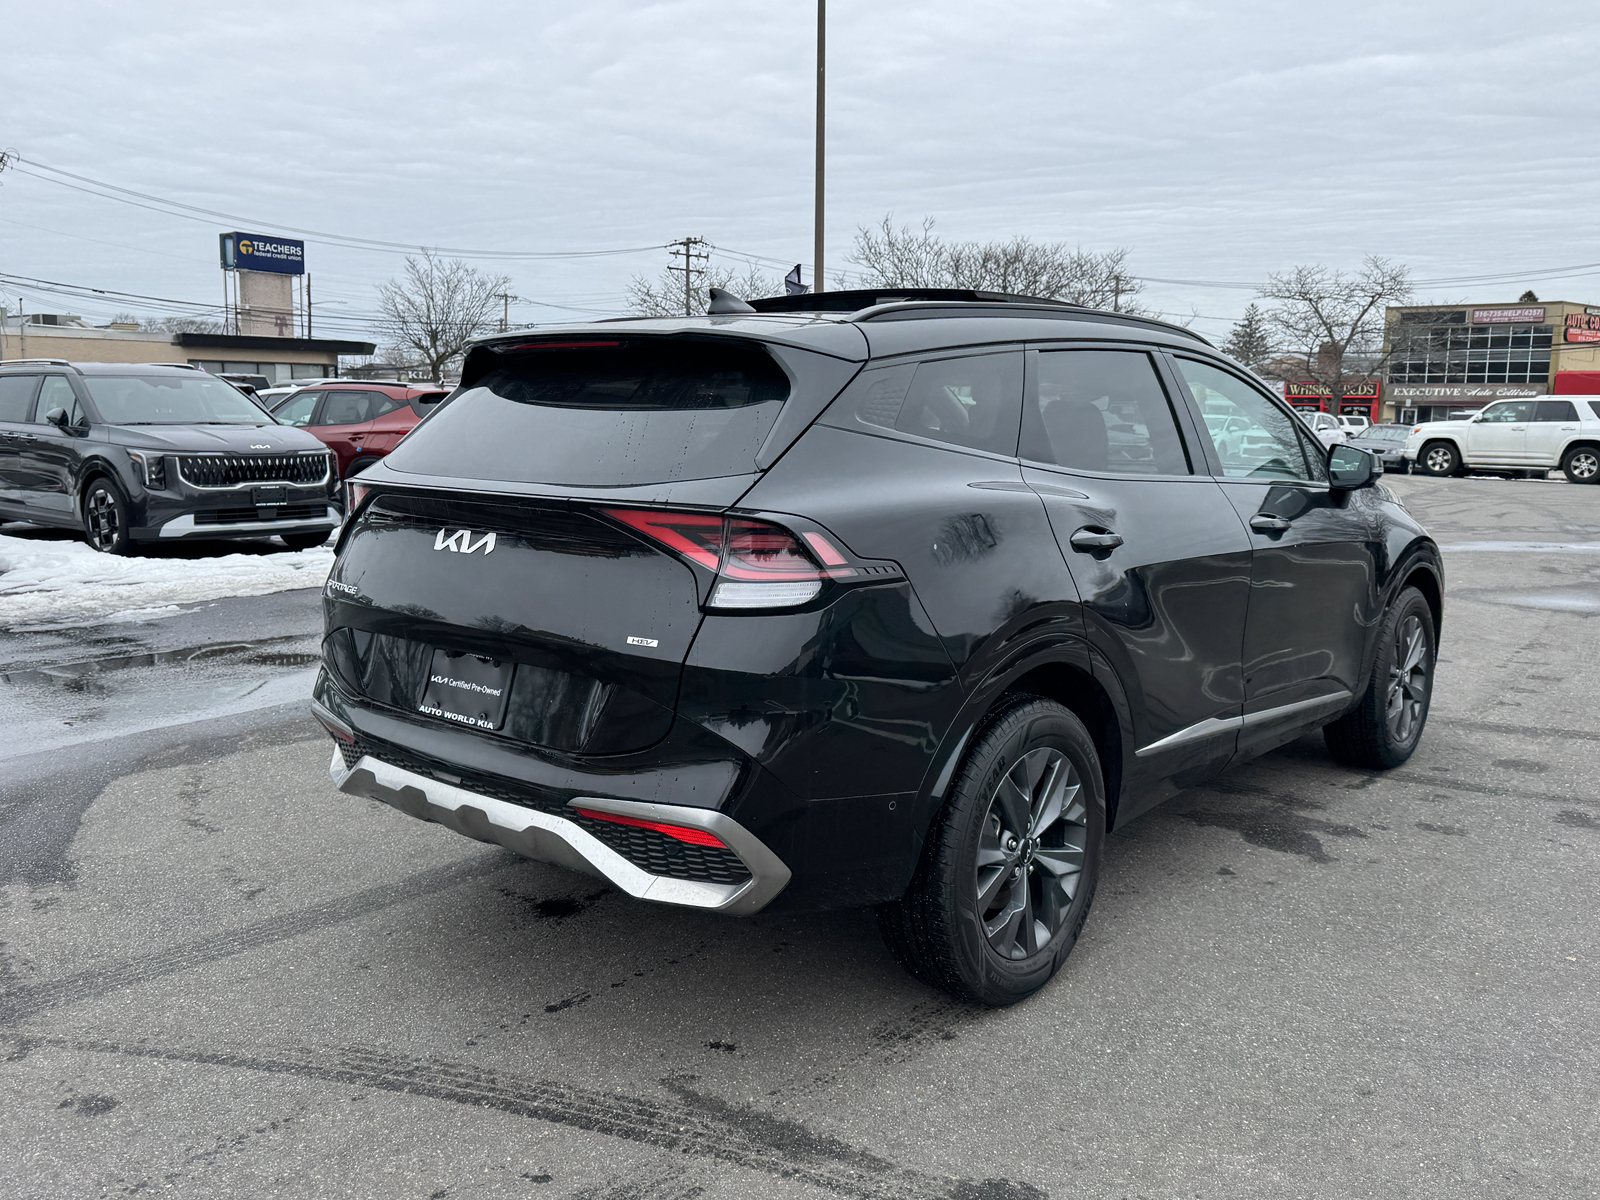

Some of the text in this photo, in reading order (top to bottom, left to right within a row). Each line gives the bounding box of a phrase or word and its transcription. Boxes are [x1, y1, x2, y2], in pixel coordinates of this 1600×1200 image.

[252, 241, 302, 255] TEACHERS
[253, 250, 272, 258] federal
[272, 252, 287, 260] credit
[1567, 314, 1586, 329] AUTO
[1289, 384, 1335, 395] WHISKE
[1393, 387, 1538, 397] EXECUTIVE Auto Collision
[433, 527, 497, 556] KIA
[449, 678, 471, 690] Certified
[471, 683, 501, 697] Pre-Owned
[419, 705, 494, 730] AUTO WORLD KIA
